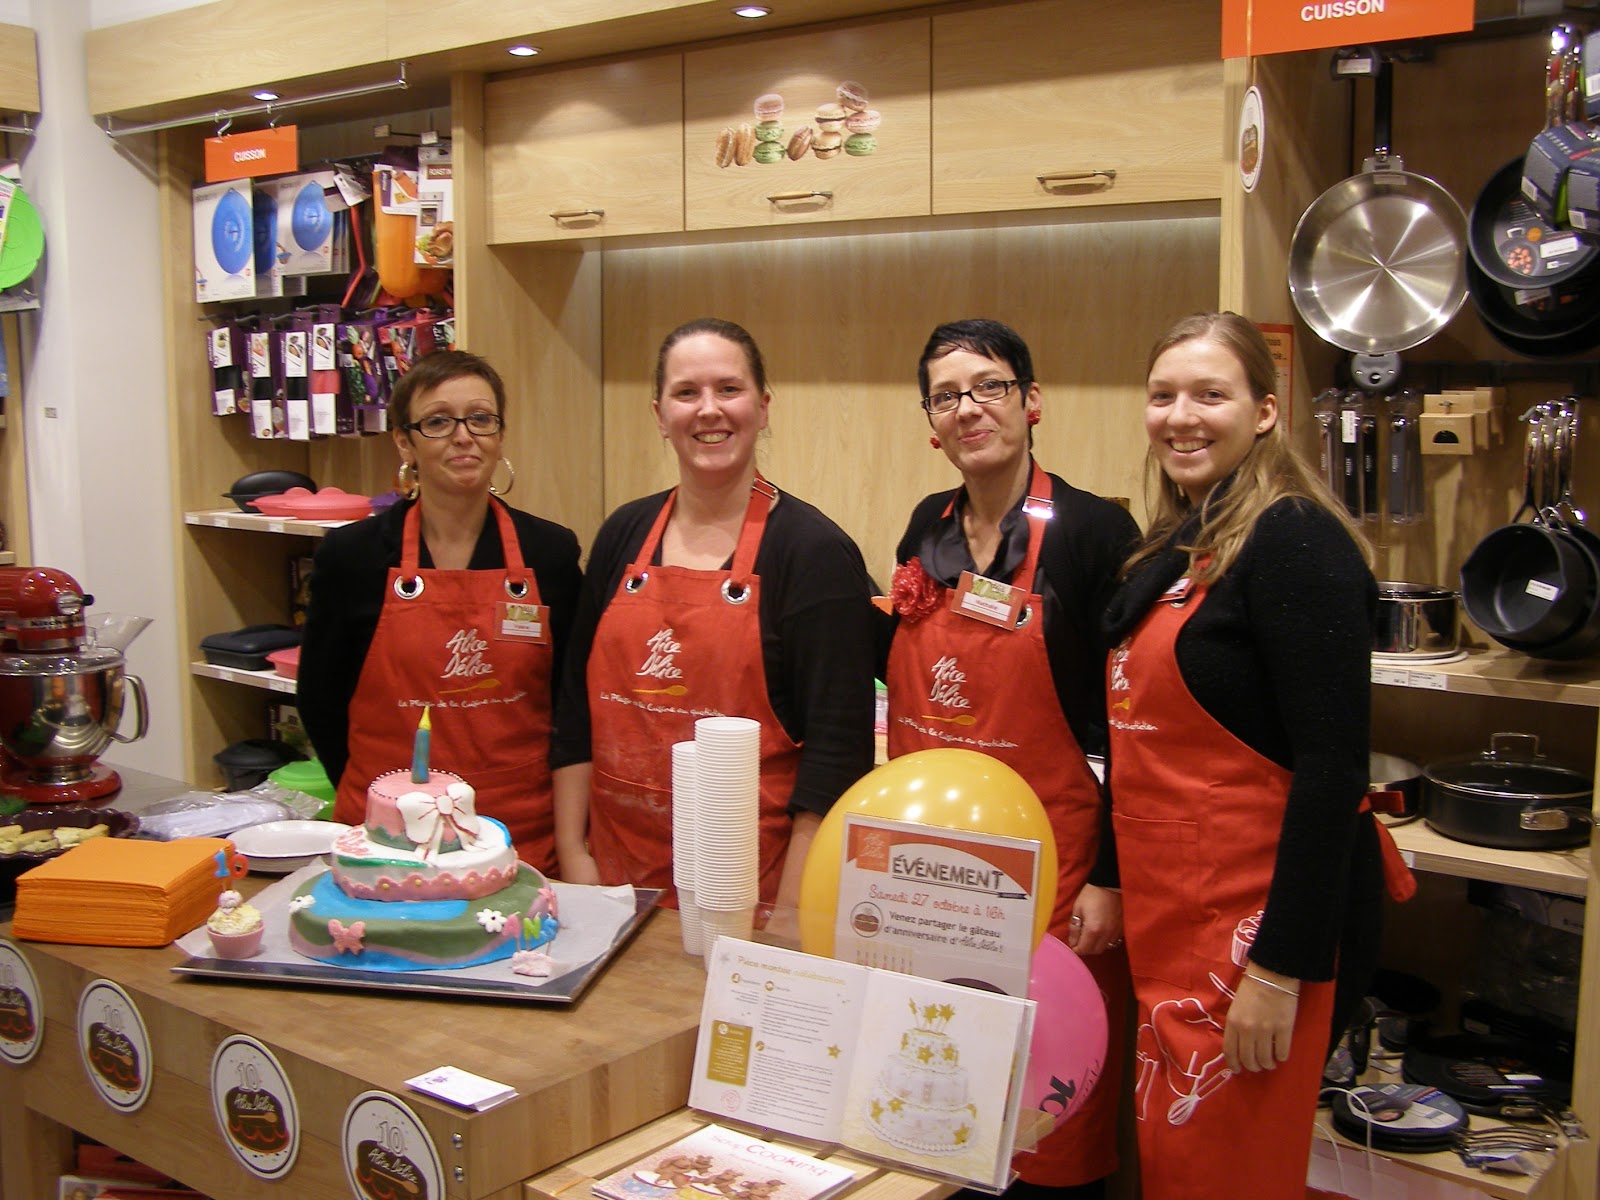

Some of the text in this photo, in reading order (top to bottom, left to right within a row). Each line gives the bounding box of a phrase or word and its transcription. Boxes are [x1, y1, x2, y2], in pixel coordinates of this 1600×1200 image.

[1300, 0, 1386, 22] CUISSON
[233, 148, 266, 163] CUISSON
[446, 628, 490, 654] Alice
[440, 652, 495, 679] Délice
[892, 854, 1004, 890] ÉVÉNEMENT
[868, 884, 908, 905] Samedi
[911, 892, 930, 907] 27
[883, 925, 948, 944] d'anniversaire
[889, 910, 1001, 939] Venez partager le gâteau
[237, 1061, 260, 1091] 10
[379, 1120, 405, 1155] 10
[746, 1144, 829, 1177] Cooking
